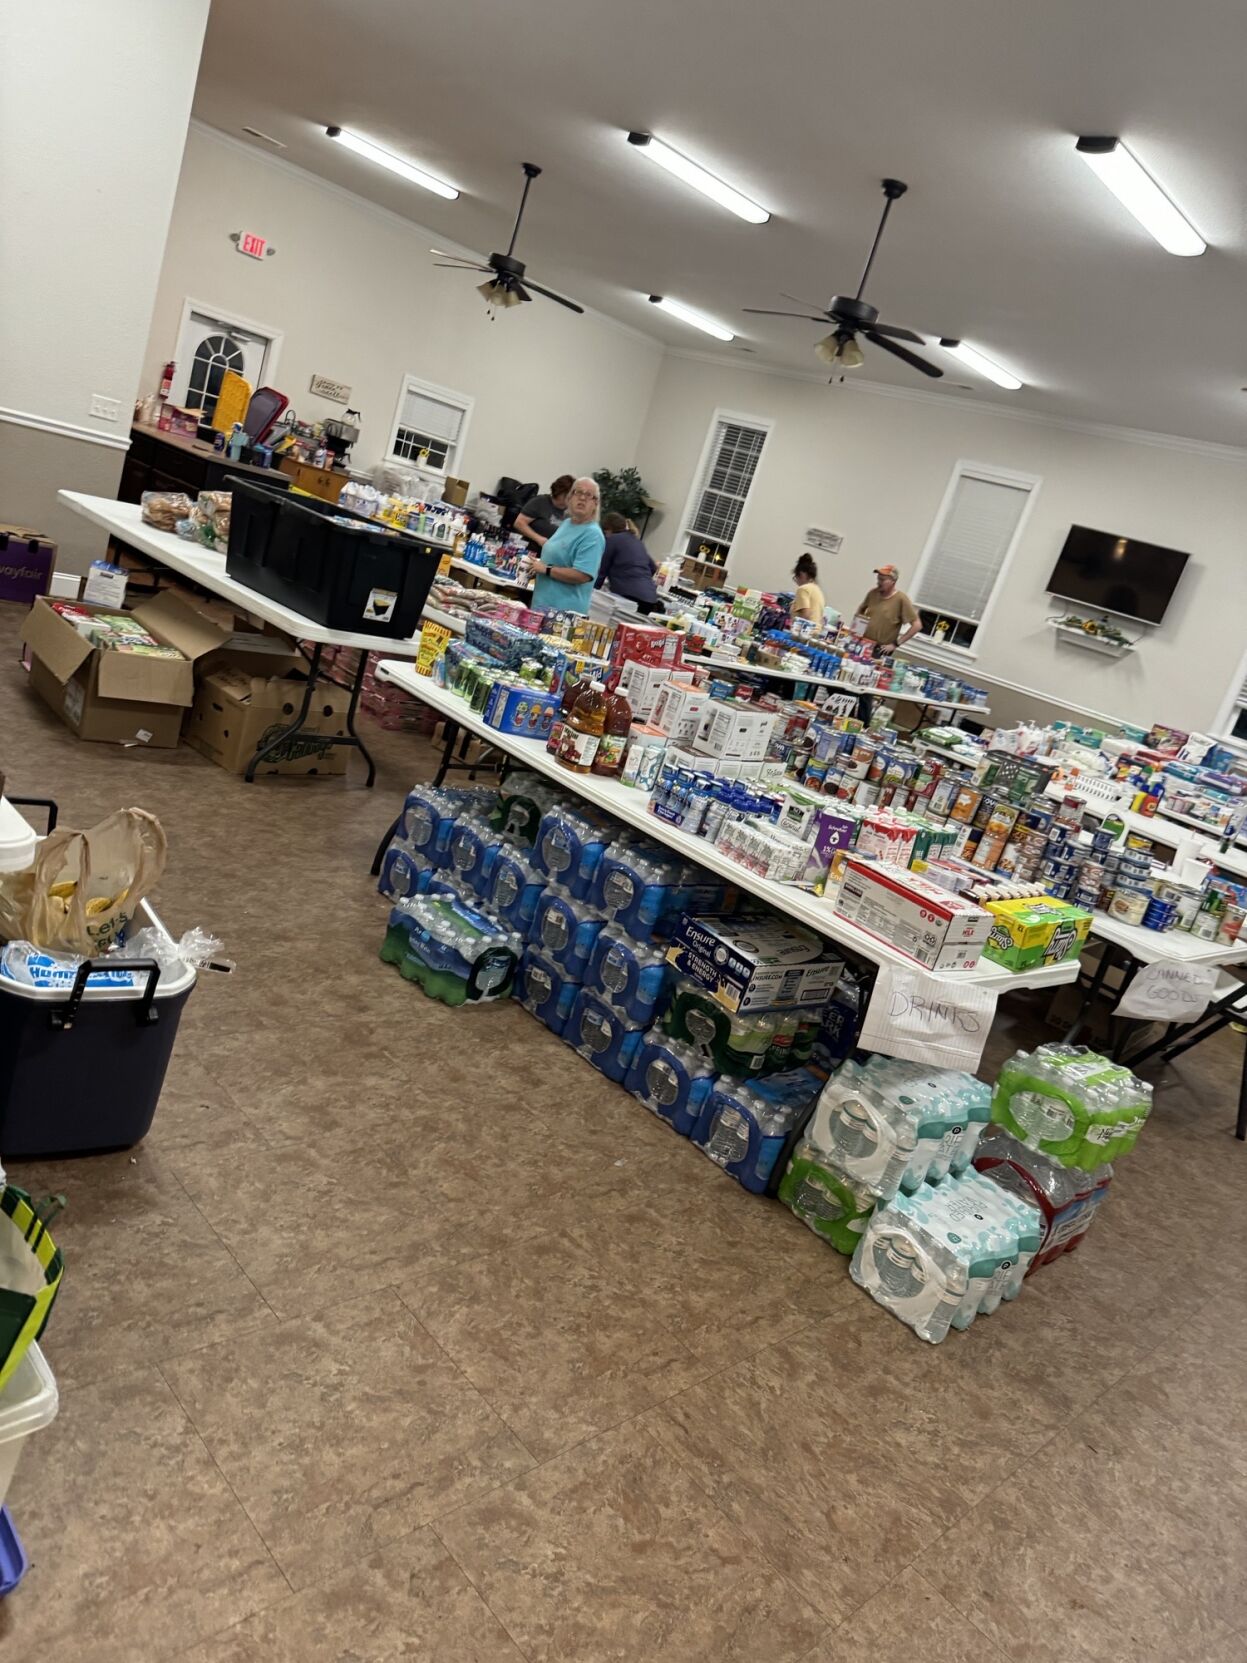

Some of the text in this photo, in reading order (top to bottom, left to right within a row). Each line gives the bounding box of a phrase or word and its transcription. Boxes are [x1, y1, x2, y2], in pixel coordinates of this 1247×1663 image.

[243, 233, 266, 257] EXIT
[685, 925, 716, 947] Ensure
[687, 951, 718, 978] STRENGTH
[889, 991, 980, 1032] DRINKS
